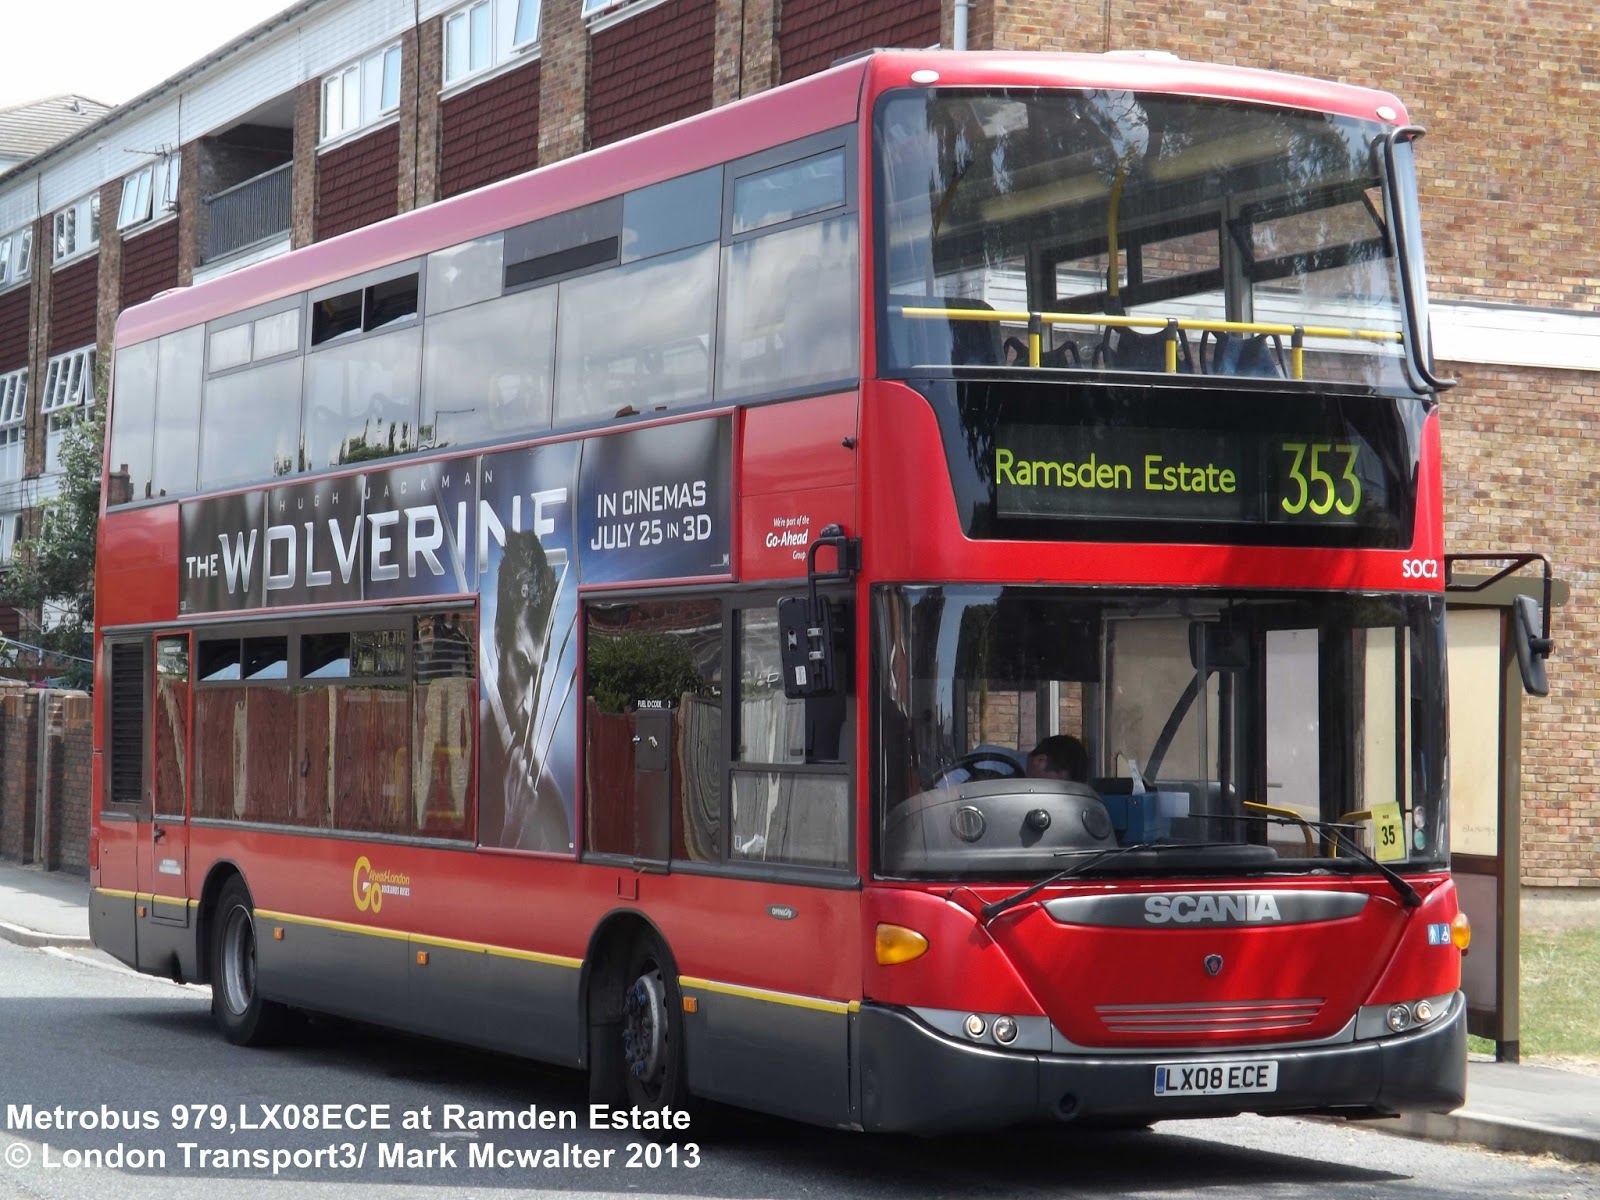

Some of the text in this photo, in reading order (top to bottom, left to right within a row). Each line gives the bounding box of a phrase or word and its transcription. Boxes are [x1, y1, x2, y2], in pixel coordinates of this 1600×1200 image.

[279, 470, 493, 513] HUGH JACKMAN
[995, 443, 1362, 516] Ramsden Estate 353
[597, 480, 706, 518] IN CINEMAS
[185, 487, 568, 595] THE WOLVERINE
[590, 513, 712, 551] JULY 25 IN 3D
[766, 528, 809, 548] Go-Ahead
[792, 550, 807, 561] Group
[1402, 558, 1438, 579] SOC2
[637, 699, 646, 708] FUEL
[1381, 824, 1396, 846] 35
[1143, 894, 1281, 924] SCANIA
[1165, 1065, 1269, 1091] LX08 ECE
